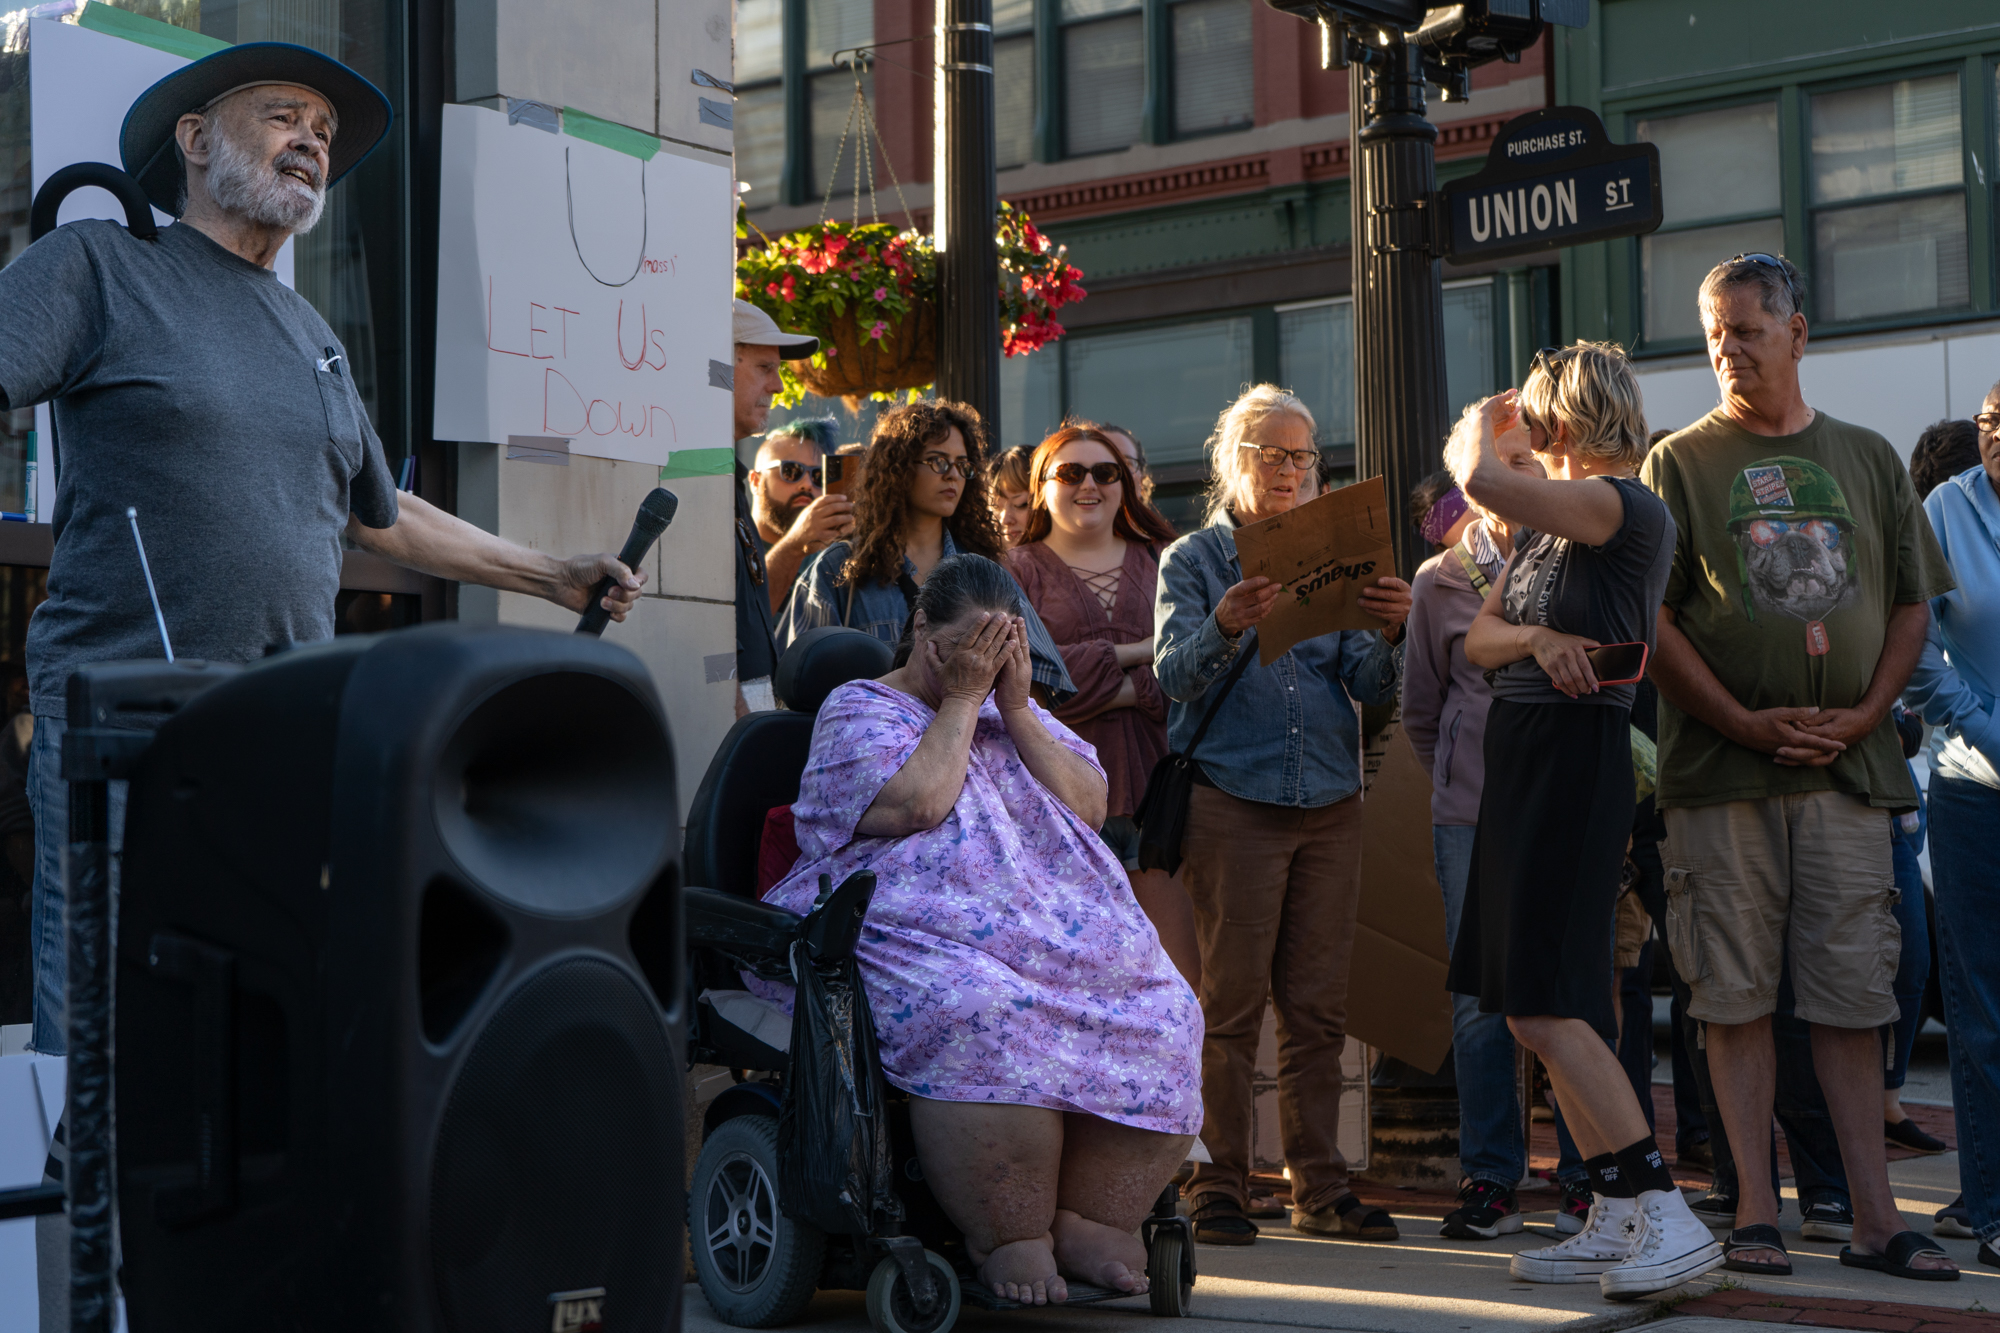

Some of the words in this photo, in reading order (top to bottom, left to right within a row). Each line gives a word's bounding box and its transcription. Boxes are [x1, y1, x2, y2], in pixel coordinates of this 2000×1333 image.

[1507, 133, 1566, 157] PURCHASE
[1569, 130, 1587, 146] ST.
[566, 147, 646, 287] U
[1469, 178, 1578, 242] UNION
[1605, 178, 1632, 207] ST
[488, 275, 580, 359] LET
[1755, 480, 1785, 496] STRIPES
[1380, 734, 1393, 742] DON'T
[1645, 1150, 1661, 1162] FUCK
[1651, 1158, 1662, 1169] OFF
[1600, 1166, 1619, 1176] FUCK
